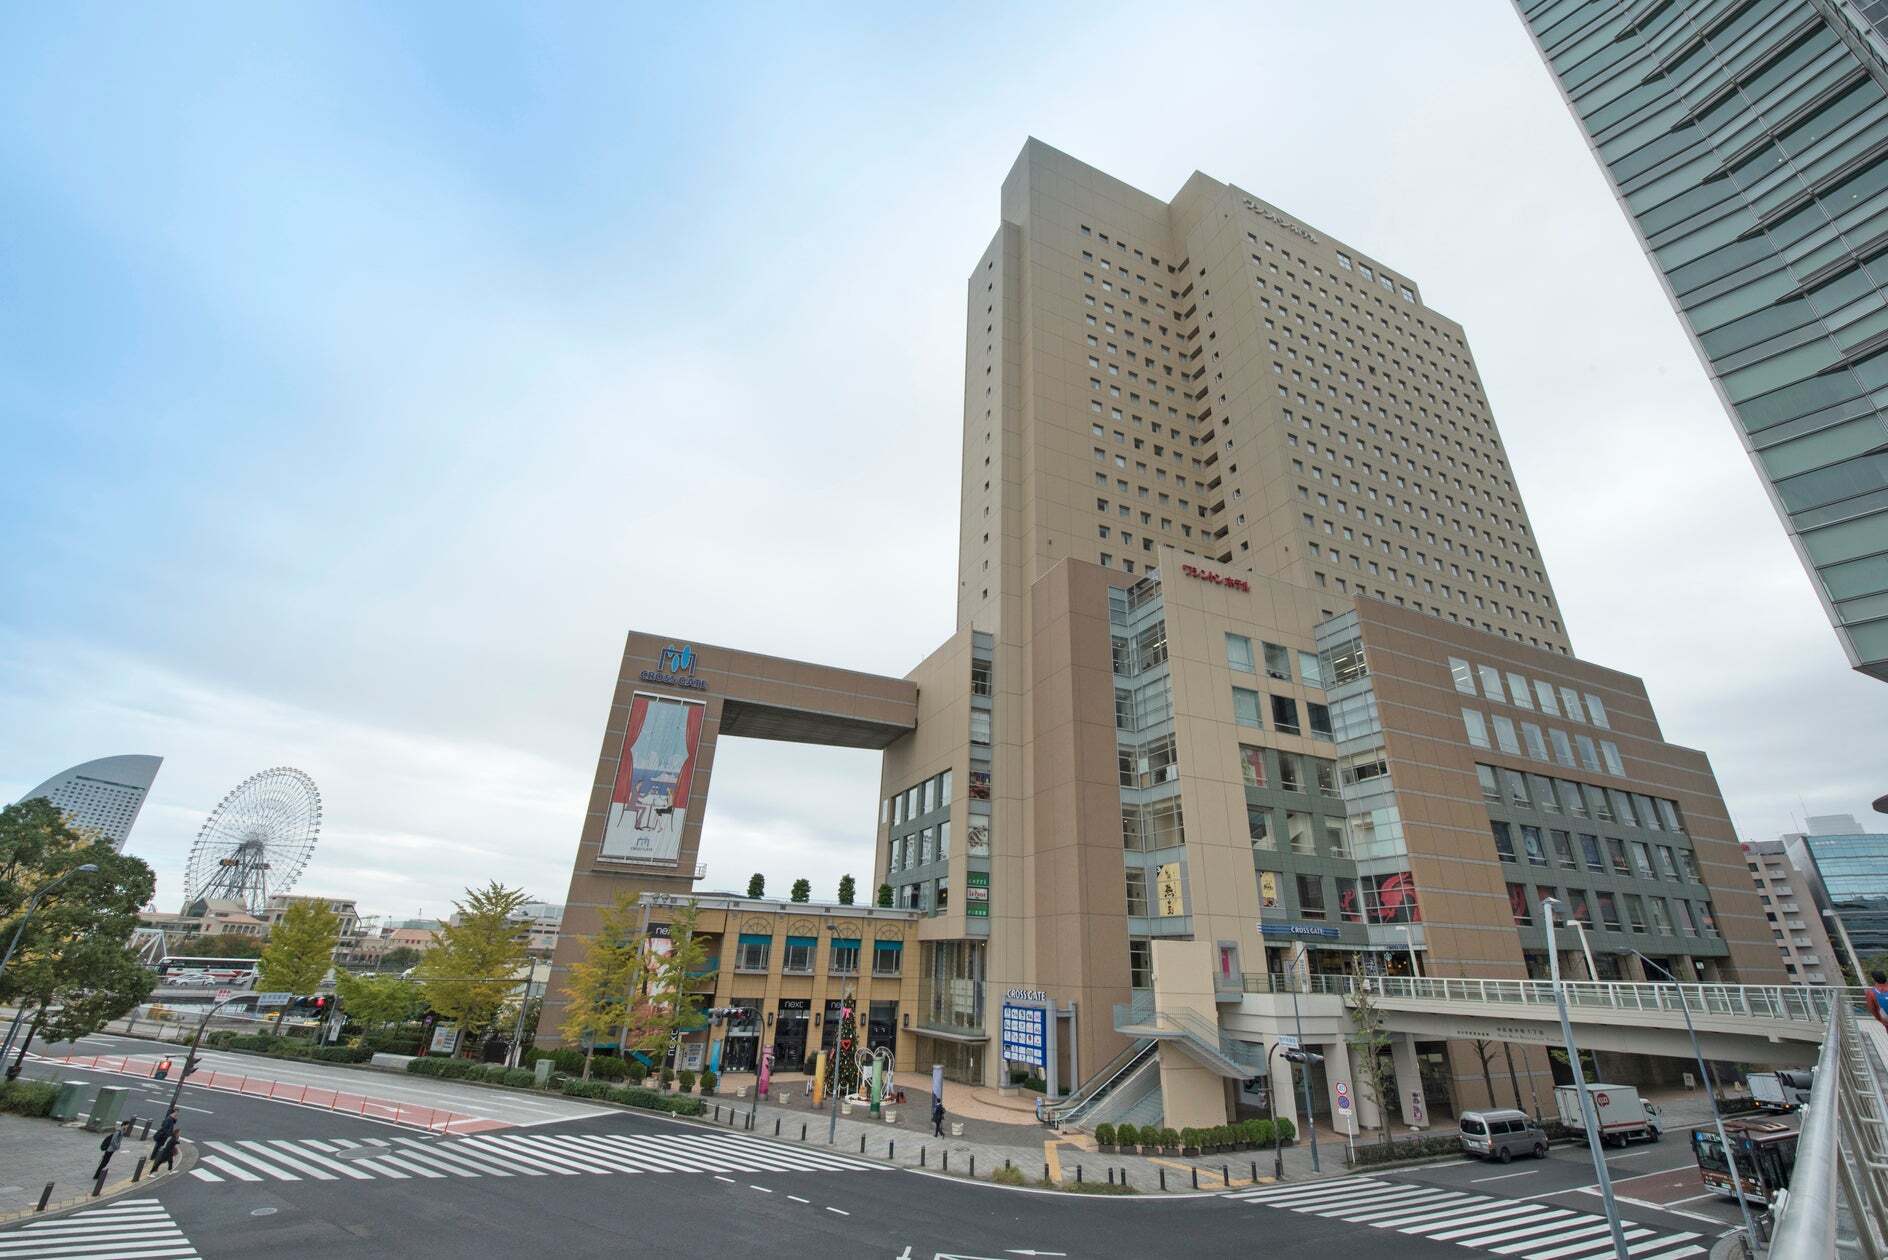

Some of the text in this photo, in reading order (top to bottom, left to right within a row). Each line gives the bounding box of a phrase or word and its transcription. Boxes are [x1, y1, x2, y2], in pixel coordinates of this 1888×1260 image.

[1007, 989, 1047, 1001] CROSS GATE
[784, 1001, 804, 1009] next
[667, 1028, 679, 1056] next
